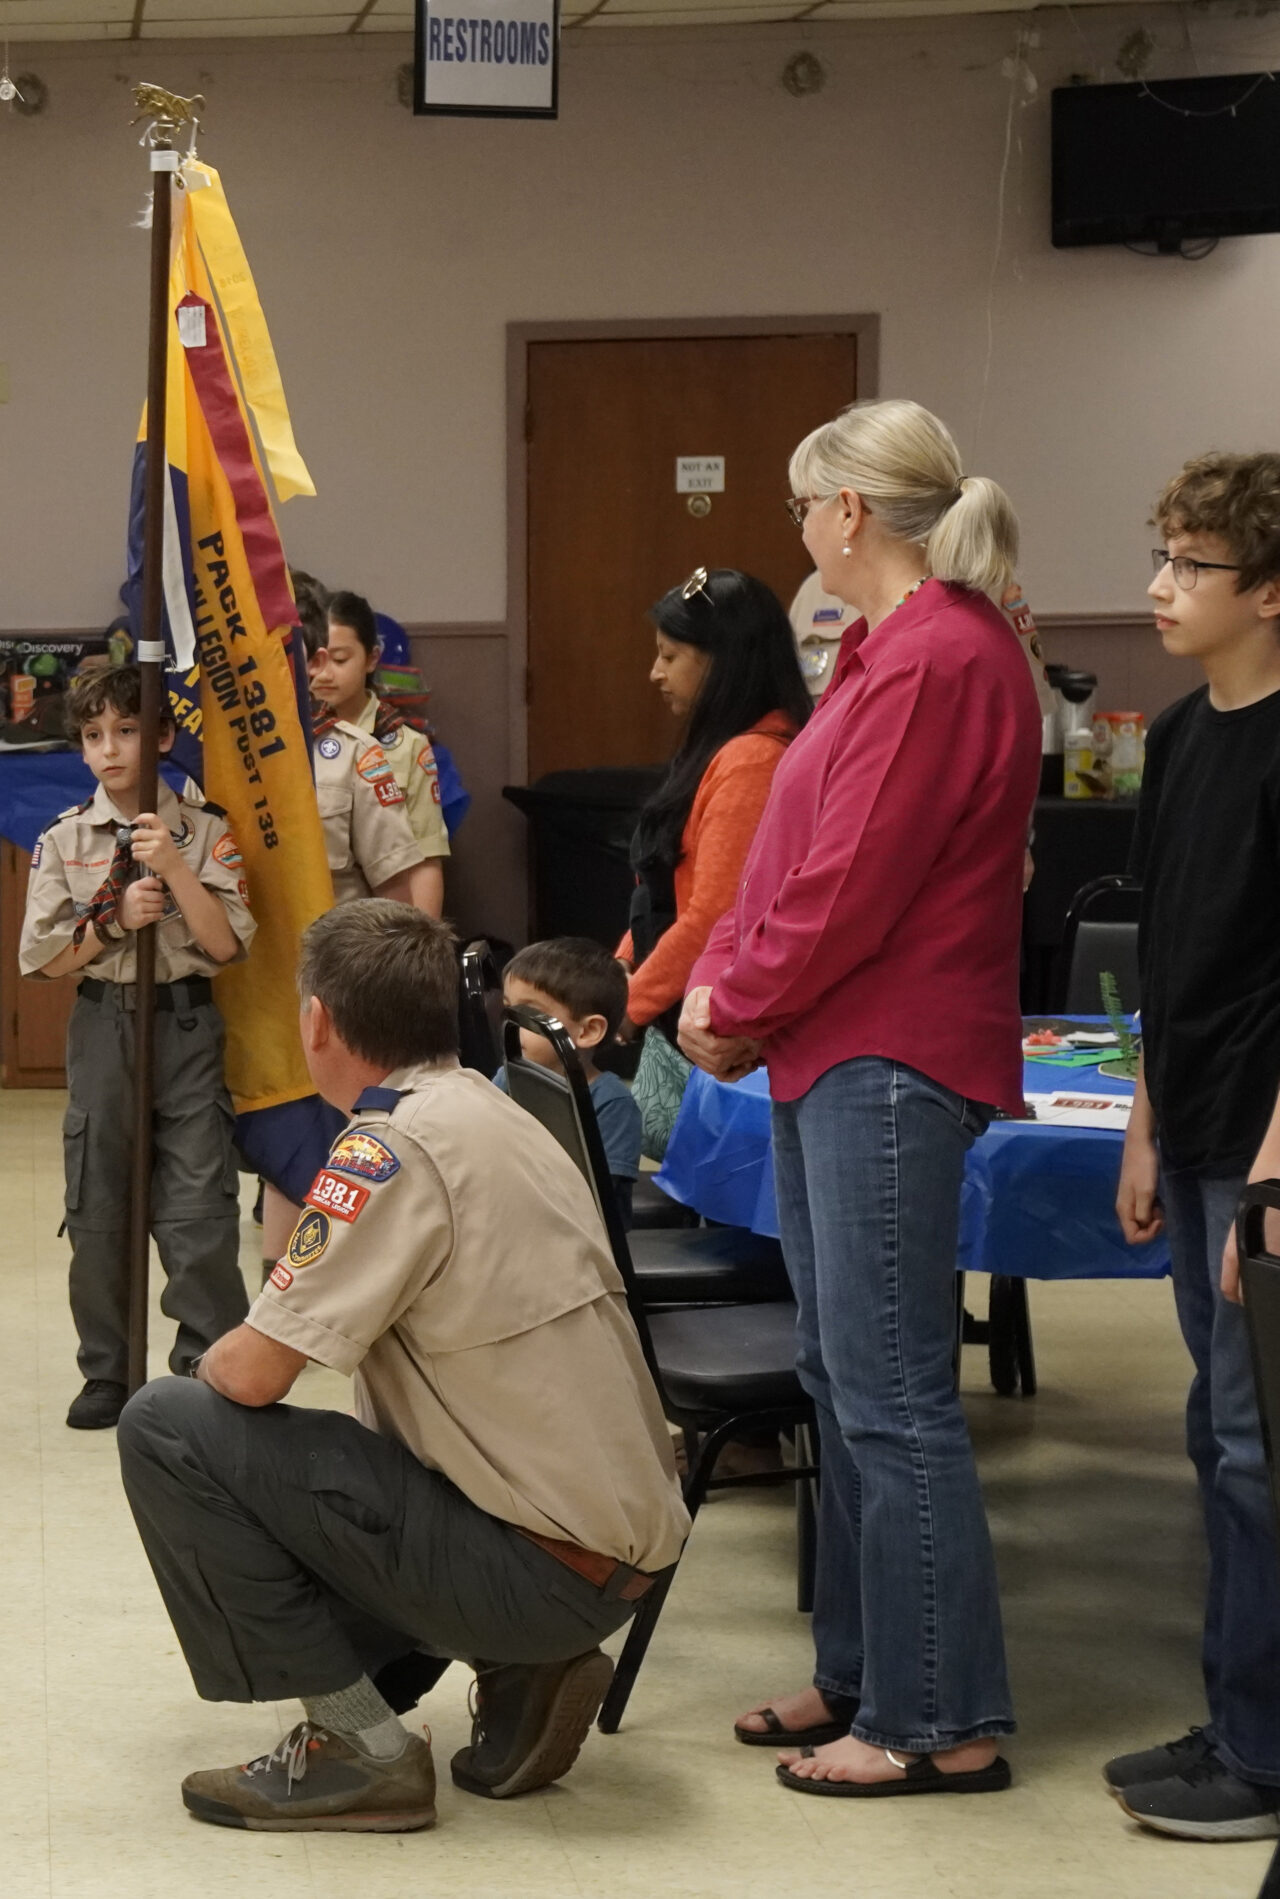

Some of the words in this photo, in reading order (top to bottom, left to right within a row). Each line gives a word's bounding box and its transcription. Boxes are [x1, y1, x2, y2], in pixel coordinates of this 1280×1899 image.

[429, 17, 550, 66] RESTROOMS
[681, 462, 701, 472] NOT
[705, 462, 720, 472] AN
[687, 478, 713, 489] EXIT
[198, 530, 248, 645] PACK
[18, 642, 84, 656] Discovery
[238, 655, 287, 760] 1381
[229, 714, 263, 784] POST
[254, 795, 280, 850] 138
[312, 1174, 360, 1212] 1381
